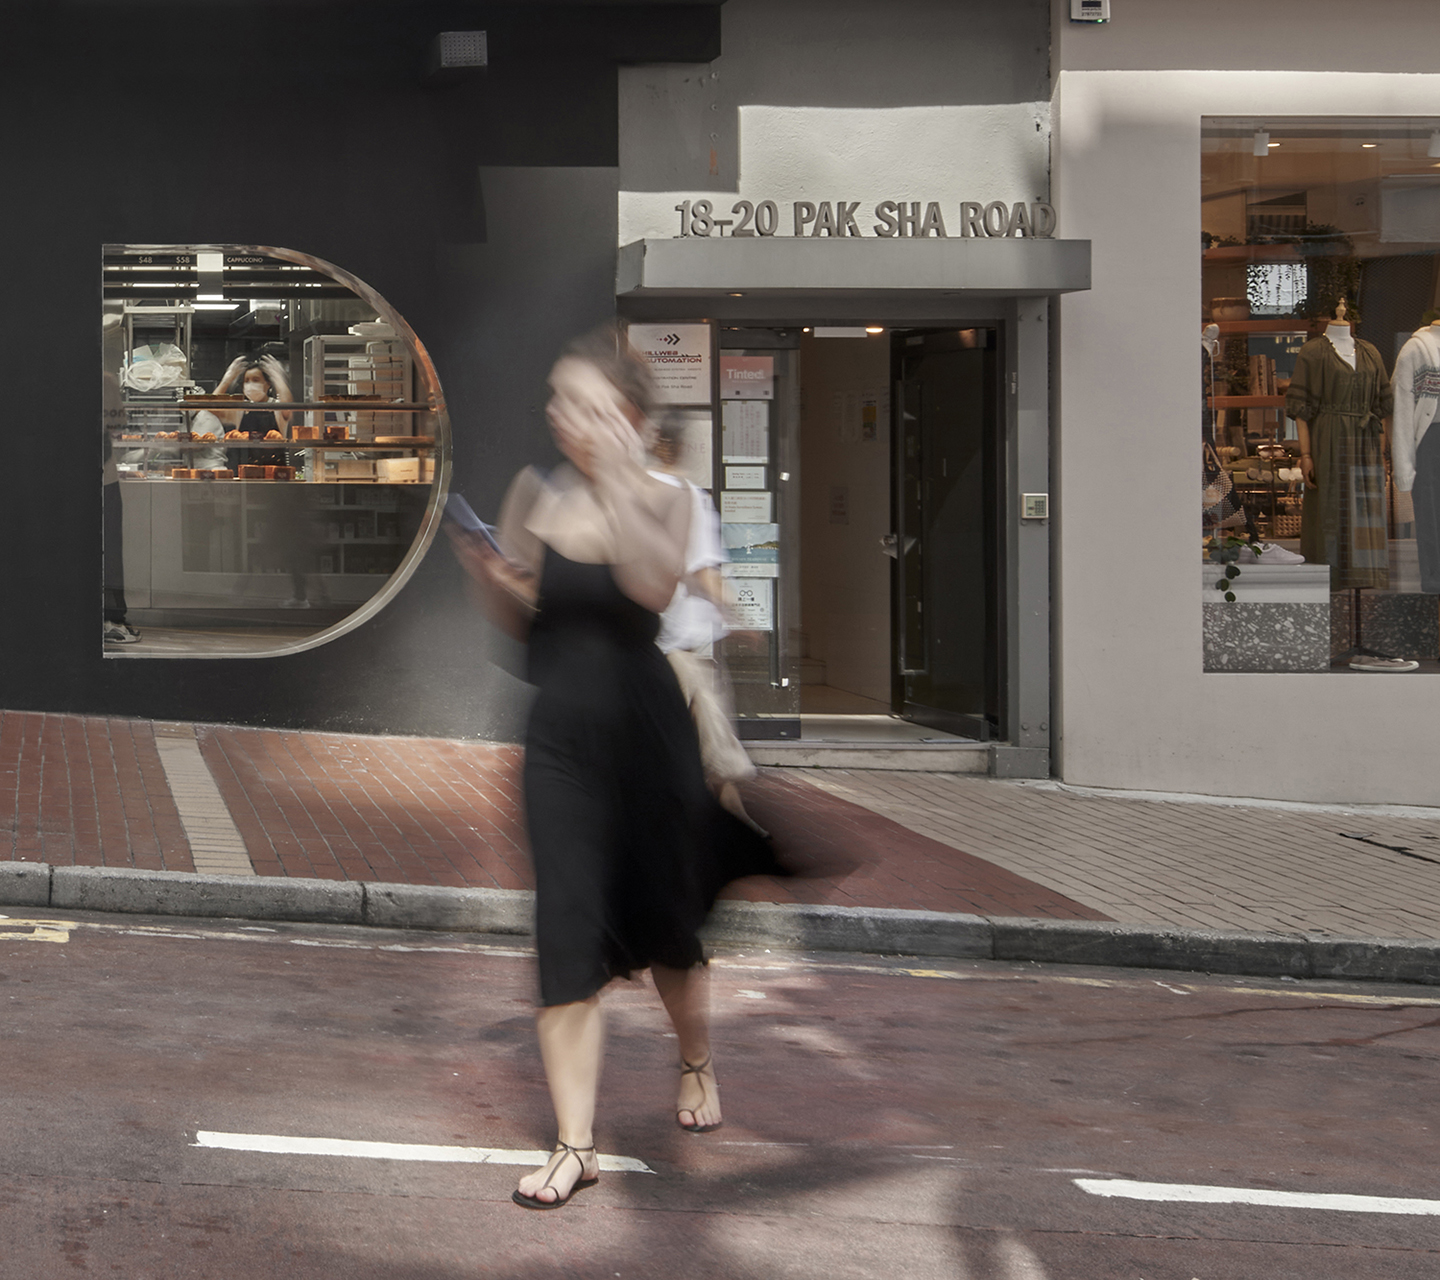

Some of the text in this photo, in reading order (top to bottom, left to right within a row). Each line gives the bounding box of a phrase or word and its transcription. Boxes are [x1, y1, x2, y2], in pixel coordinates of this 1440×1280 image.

[675, 199, 1057, 238] 18-20 PAK SHA ROAD
[138, 256, 153, 264] $48
[176, 256, 190, 264] $58
